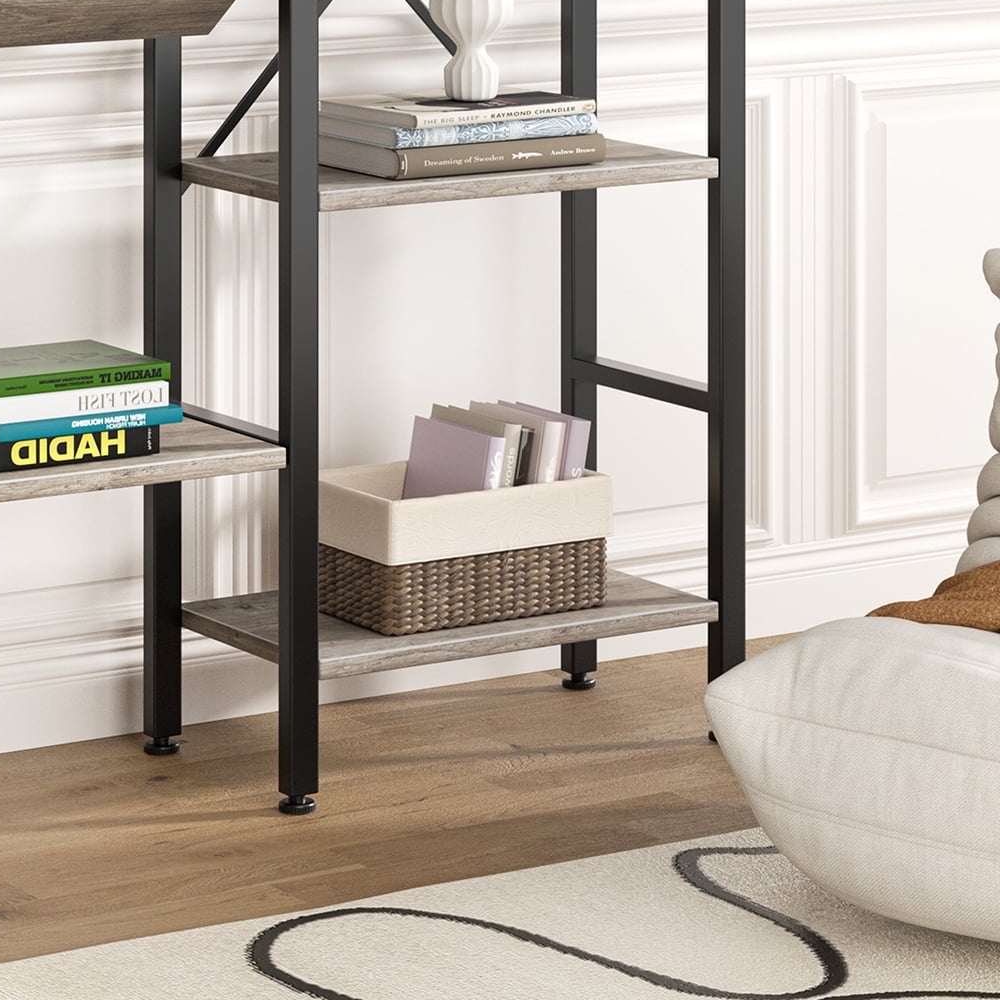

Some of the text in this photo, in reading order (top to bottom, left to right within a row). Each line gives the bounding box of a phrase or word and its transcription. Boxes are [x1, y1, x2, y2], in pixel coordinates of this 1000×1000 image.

[490, 110, 532, 119] RAYMOND
[534, 106, 576, 115] CHANDLER
[550, 146, 596, 157] Andrew Brown
[423, 153, 505, 168] Dreaming of Sweden
